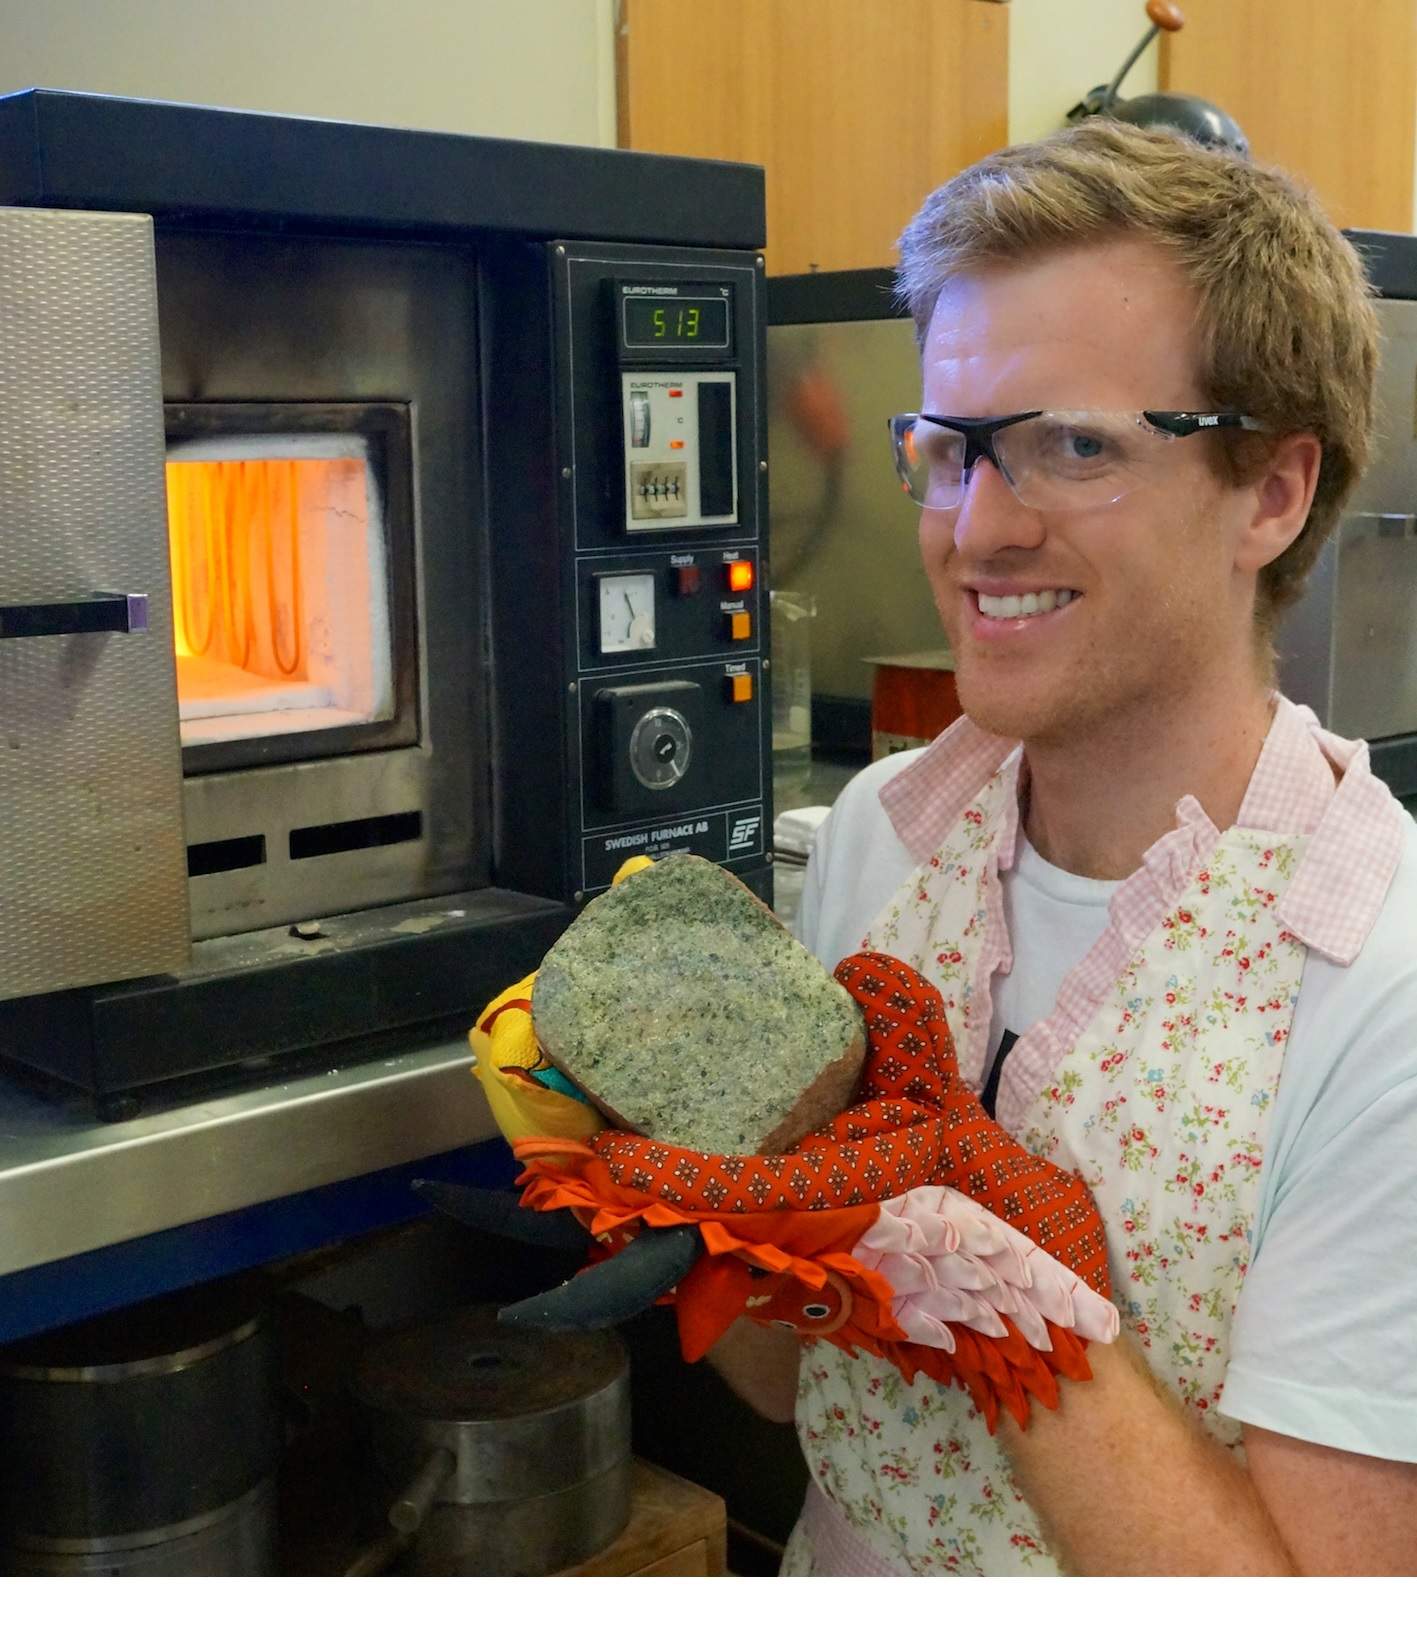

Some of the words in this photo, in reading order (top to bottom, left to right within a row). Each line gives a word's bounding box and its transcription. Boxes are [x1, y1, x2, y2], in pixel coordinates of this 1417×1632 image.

[622, 286, 677, 295] EUROTHERM
[654, 309, 699, 337] 513
[1198, 416, 1219, 427] uvex
[670, 555, 694, 565] Supply
[720, 600, 744, 610] Manual
[725, 663, 746, 673] Timed
[605, 832, 649, 851] SWEDISH
[651, 825, 694, 842] FURNACE
[695, 821, 709, 833] AB
